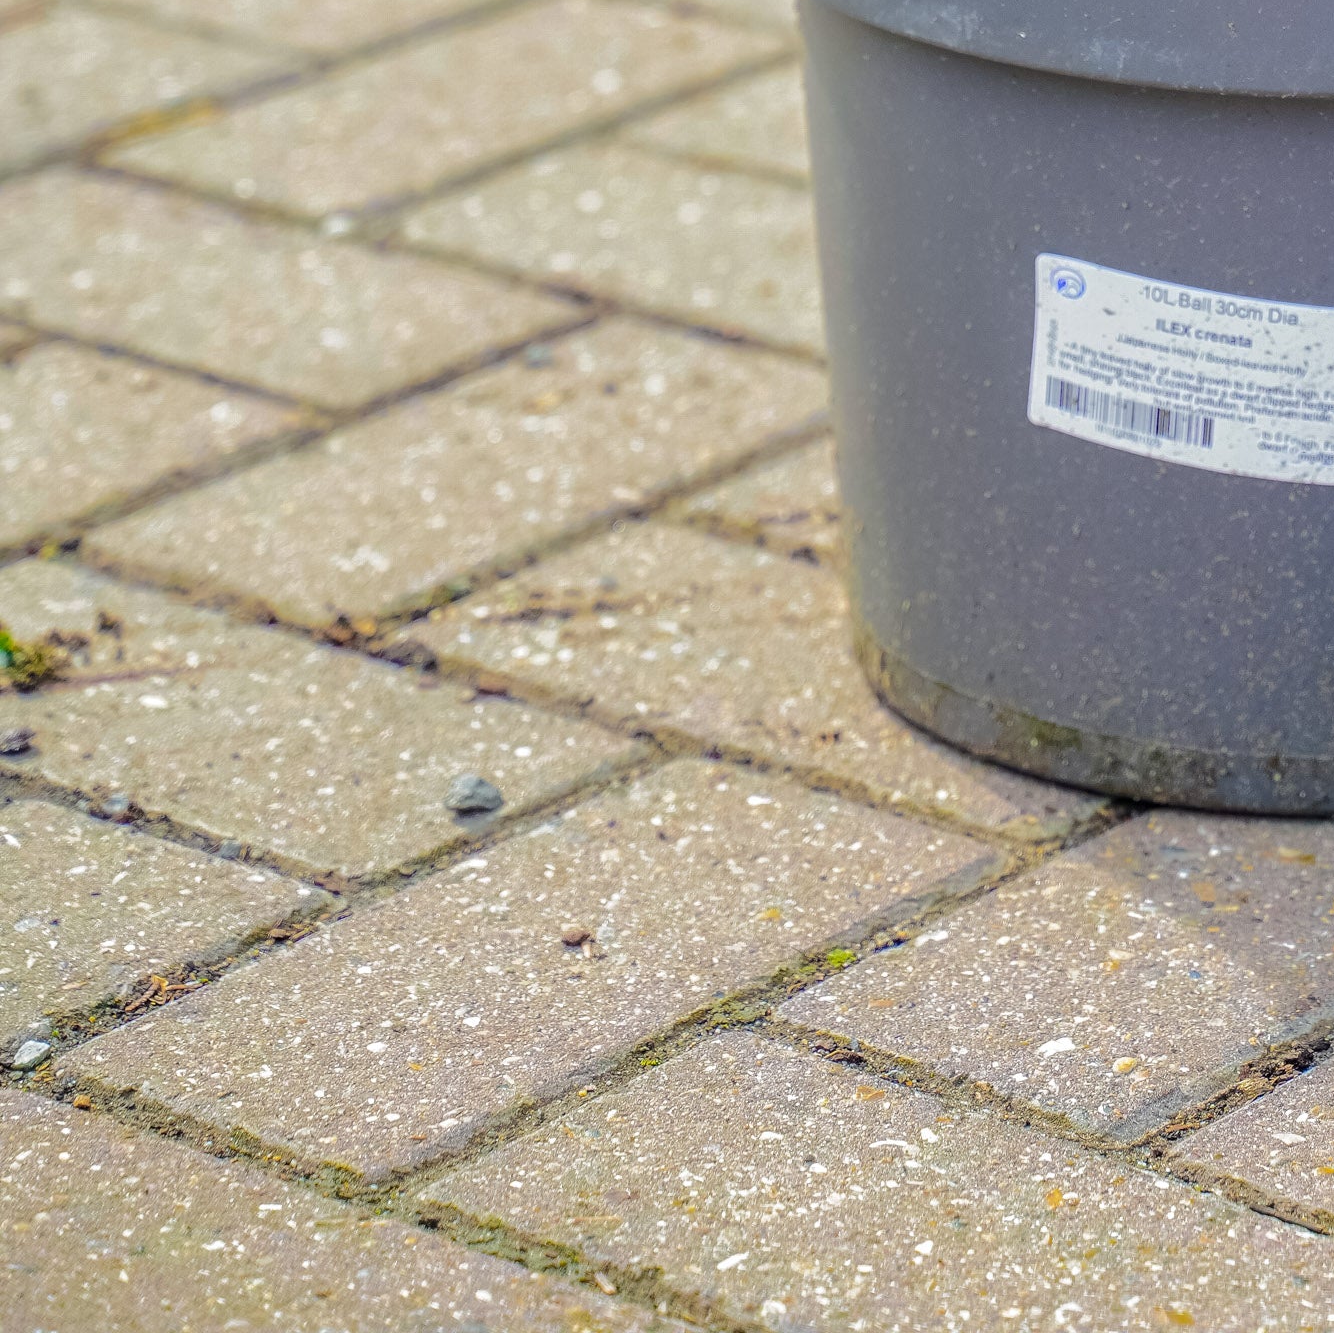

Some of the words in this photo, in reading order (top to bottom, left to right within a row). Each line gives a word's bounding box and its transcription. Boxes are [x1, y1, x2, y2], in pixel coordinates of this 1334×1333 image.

[1143, 285, 1176, 307] 10L
[1178, 292, 1212, 312] Ball
[1215, 299, 1264, 322] 30cm
[1268, 307, 1299, 326] Dia
[1156, 318, 1192, 338] ILEX
[1194, 328, 1253, 349] crenata
